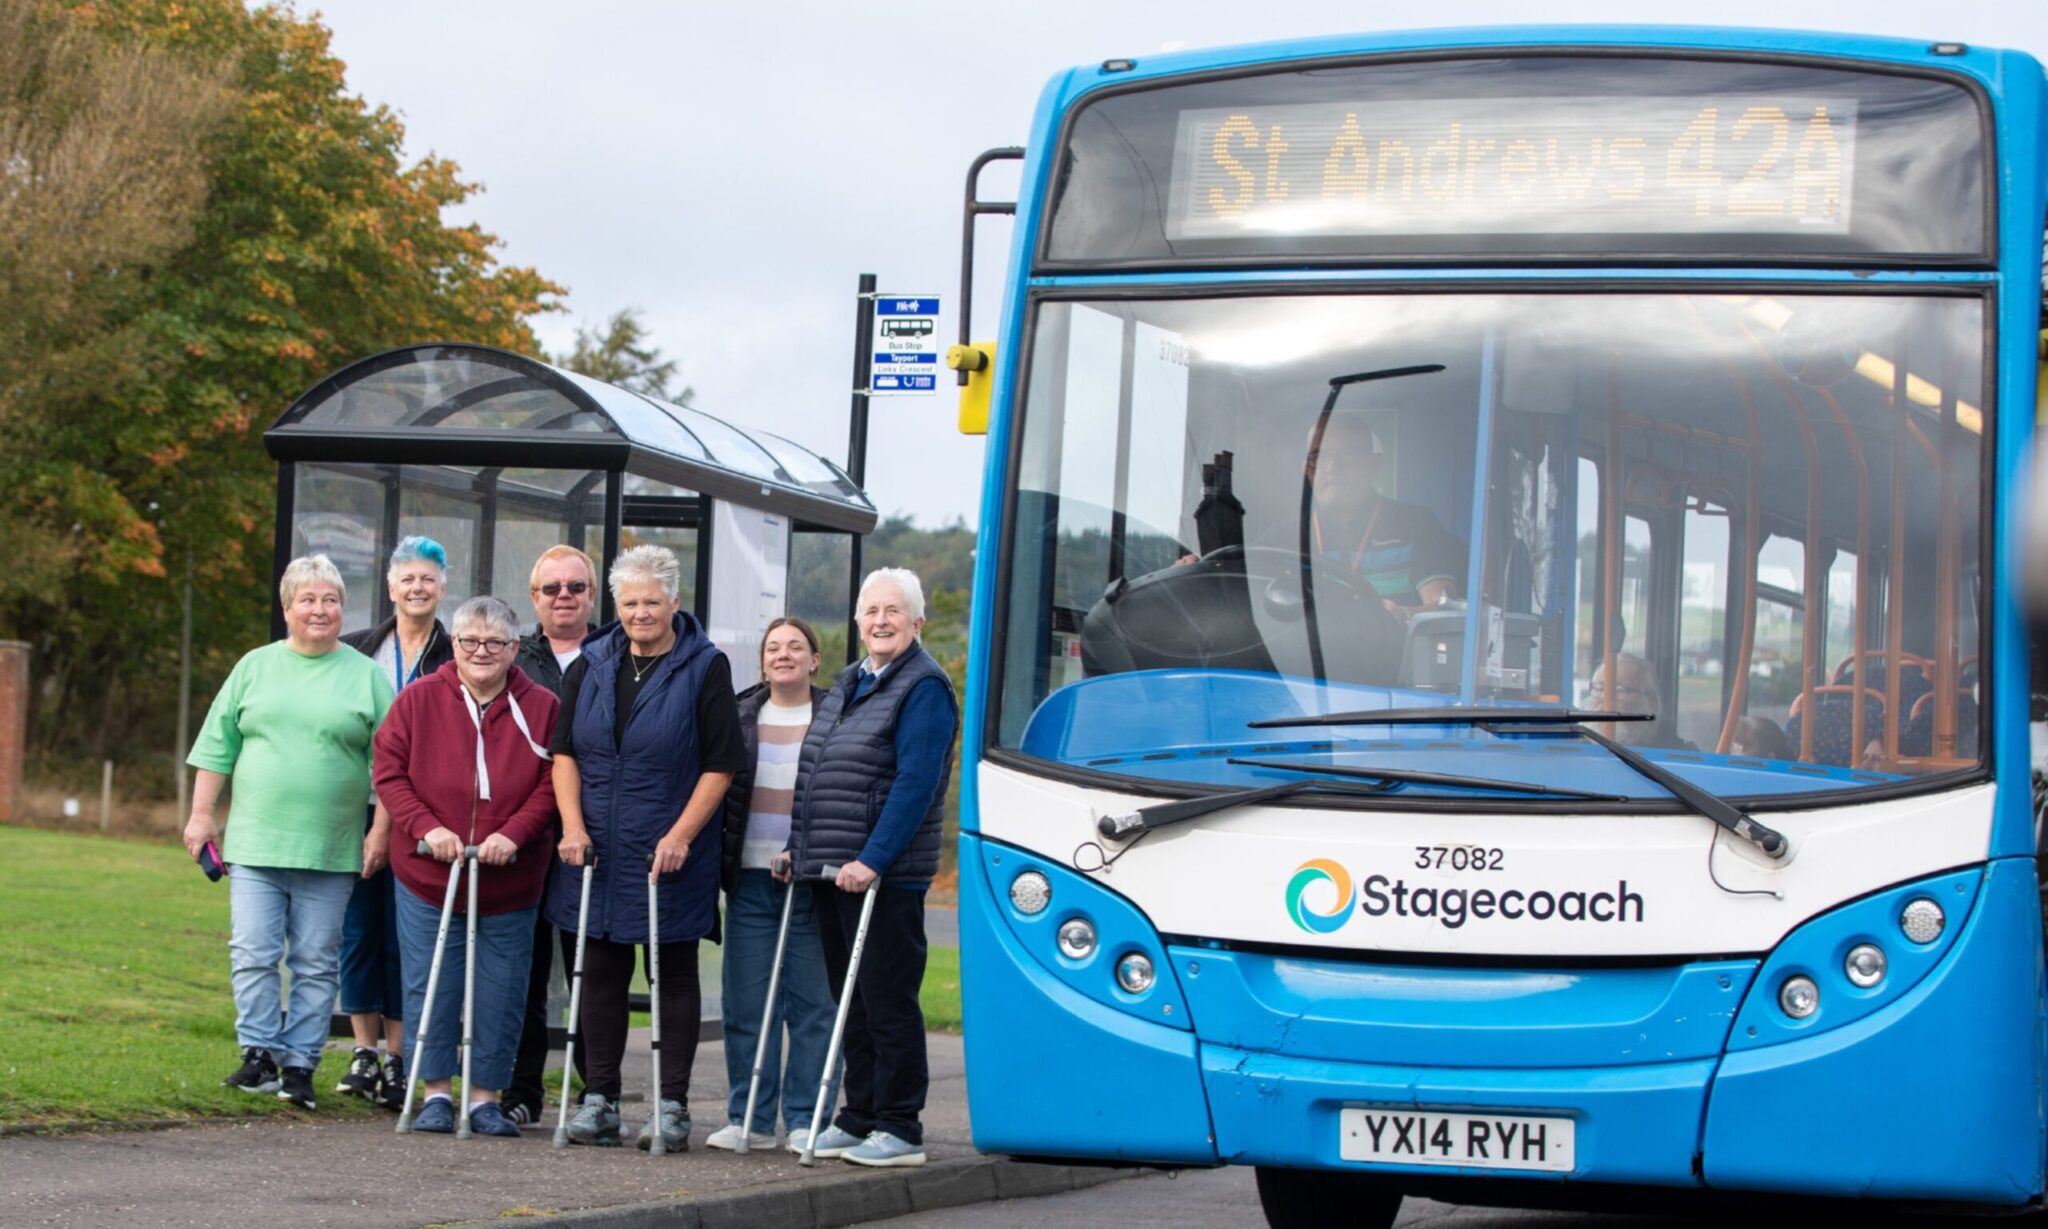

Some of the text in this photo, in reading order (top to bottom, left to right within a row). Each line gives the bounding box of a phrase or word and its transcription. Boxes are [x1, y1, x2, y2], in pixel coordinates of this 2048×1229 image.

[1208, 105, 1842, 219] St Andrews 42A
[888, 341, 923, 351] Bus Stop
[890, 352, 919, 363] Tayport
[1414, 846, 1504, 871] 37082
[1361, 874, 1644, 929] Stagecoach
[1365, 1115, 1546, 1161] YX14 RYH
